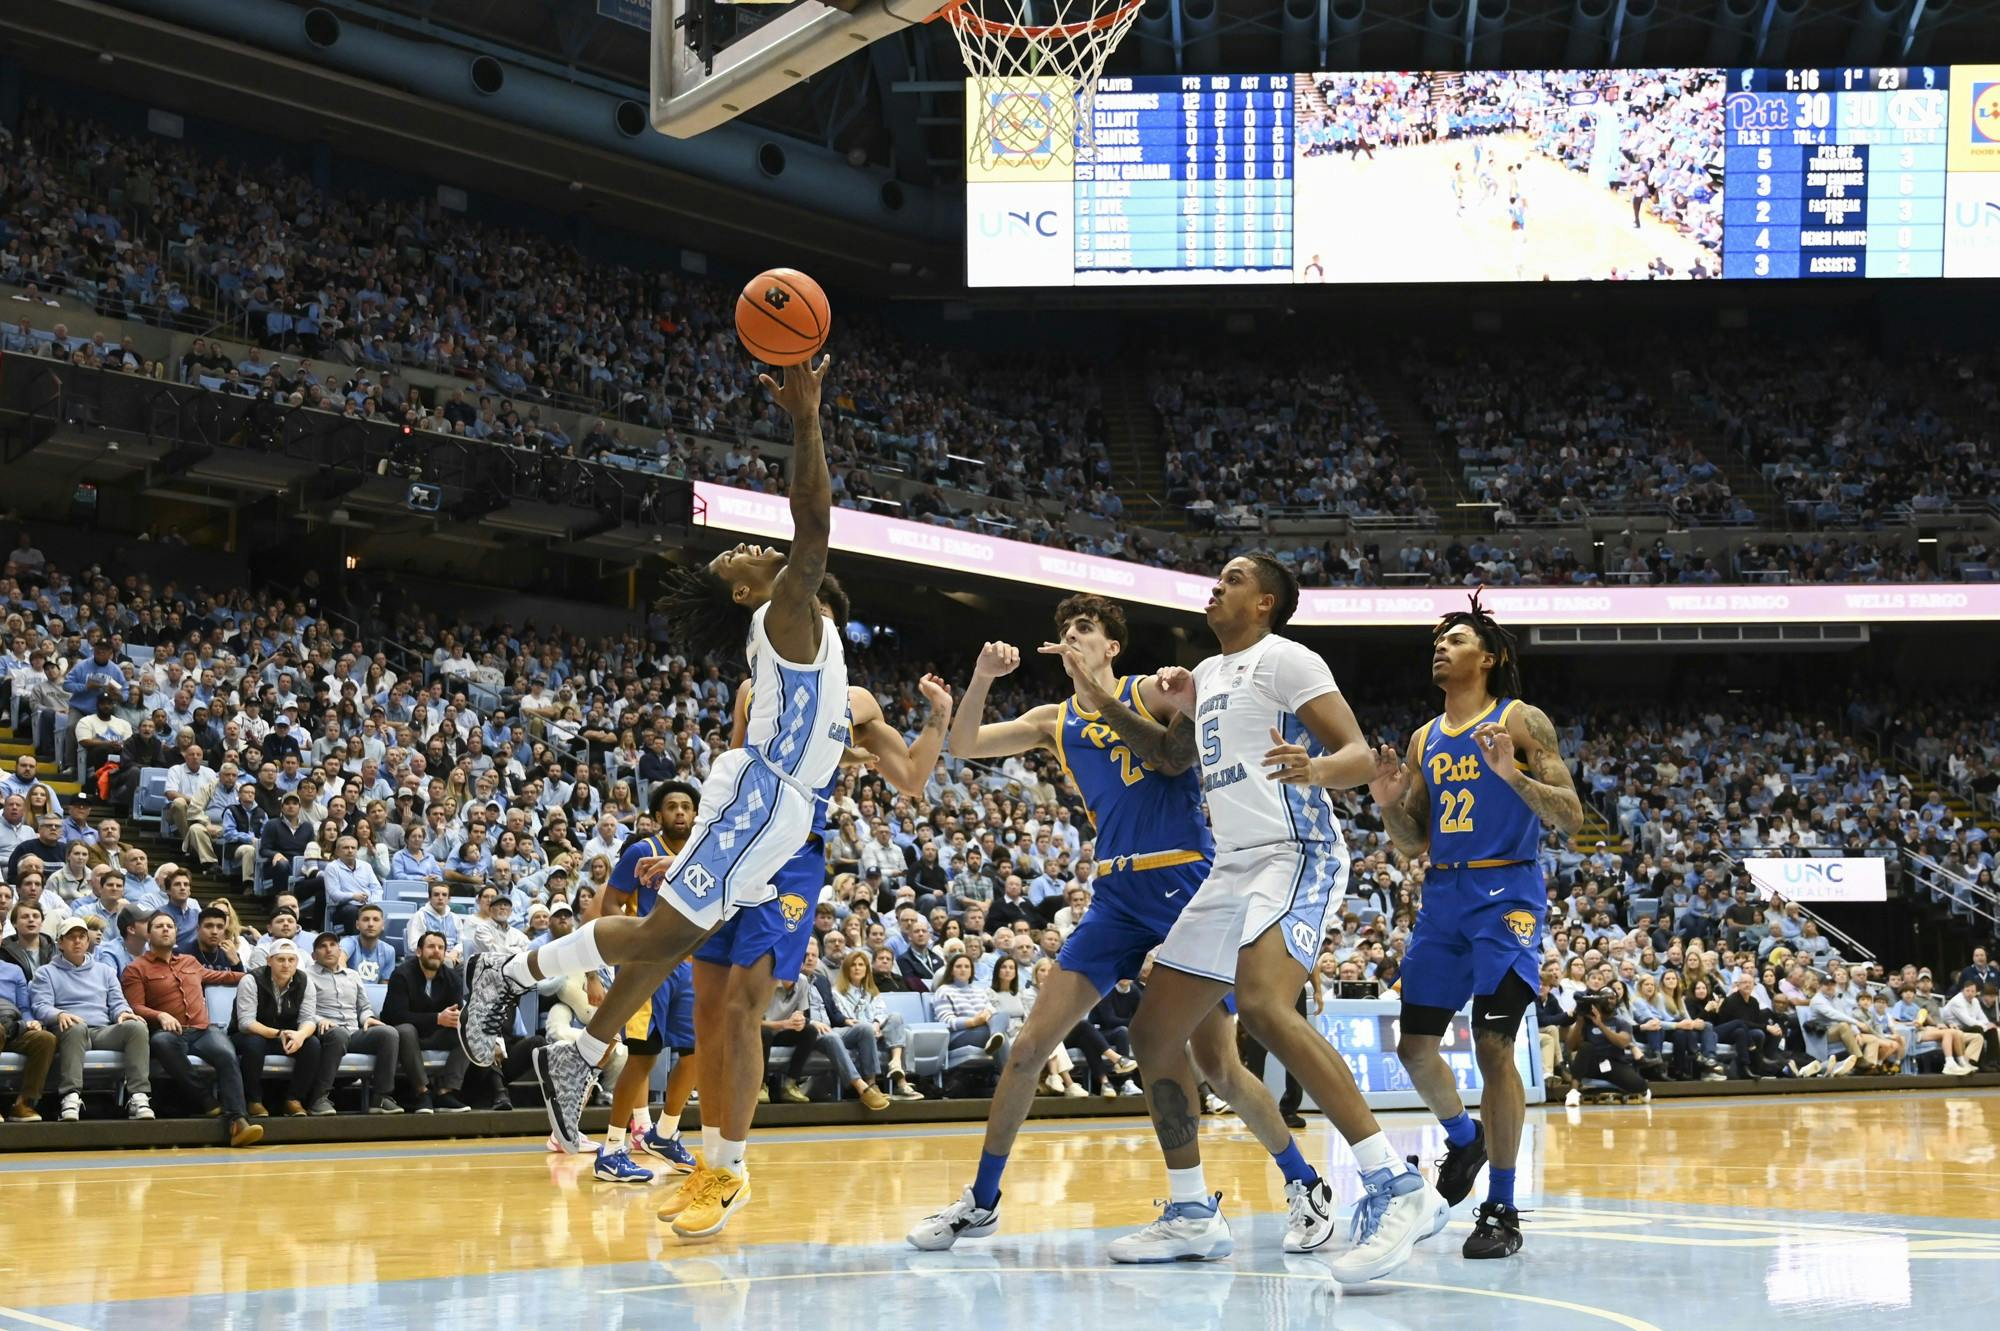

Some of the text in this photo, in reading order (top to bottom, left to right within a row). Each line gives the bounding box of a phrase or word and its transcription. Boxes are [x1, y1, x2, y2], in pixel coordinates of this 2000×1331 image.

[1098, 79, 1132, 91] PLAYER
[1182, 77, 1201, 89] PTS
[1241, 76, 1259, 89] AST
[1270, 76, 1288, 89] FLS
[1786, 70, 1819, 90] 1:16
[1879, 69, 1899, 89] 23
[1183, 92, 1200, 109] 12
[1215, 92, 1226, 109] 0
[1246, 92, 1254, 108] 1
[1273, 92, 1284, 108] 0
[1725, 92, 1789, 129] Pitt
[1796, 93, 1878, 128] 30 30
[1186, 110, 1198, 127] 5
[1215, 110, 1226, 127] 2
[1244, 110, 1256, 126] 0
[1275, 109, 1283, 126] 1
[1186, 128, 1198, 144] 0
[1217, 128, 1224, 144] 1
[1244, 127, 1256, 144] 0
[1273, 127, 1284, 143] 2
[1186, 146, 1198, 162] 4
[1215, 145, 1226, 161] 3
[1244, 144, 1256, 161] 0
[1273, 144, 1284, 160] 0
[1758, 148, 1772, 169] 5
[1186, 162, 1198, 179] 0
[1215, 162, 1226, 179] 0
[1244, 162, 1256, 179] 0
[1273, 162, 1284, 178] 0
[1757, 175, 1770, 196] 3
[1756, 202, 1770, 222] 2
[979, 207, 1058, 239] UNC
[1756, 228, 1770, 249] 4
[1755, 254, 1769, 276] 3
[1202, 716, 1222, 767] 5
[1427, 752, 1481, 786] Pitt
[1440, 788, 1476, 834] 22
[1784, 862, 1844, 884] UNC
[1785, 888, 1844, 898] HEALTH
